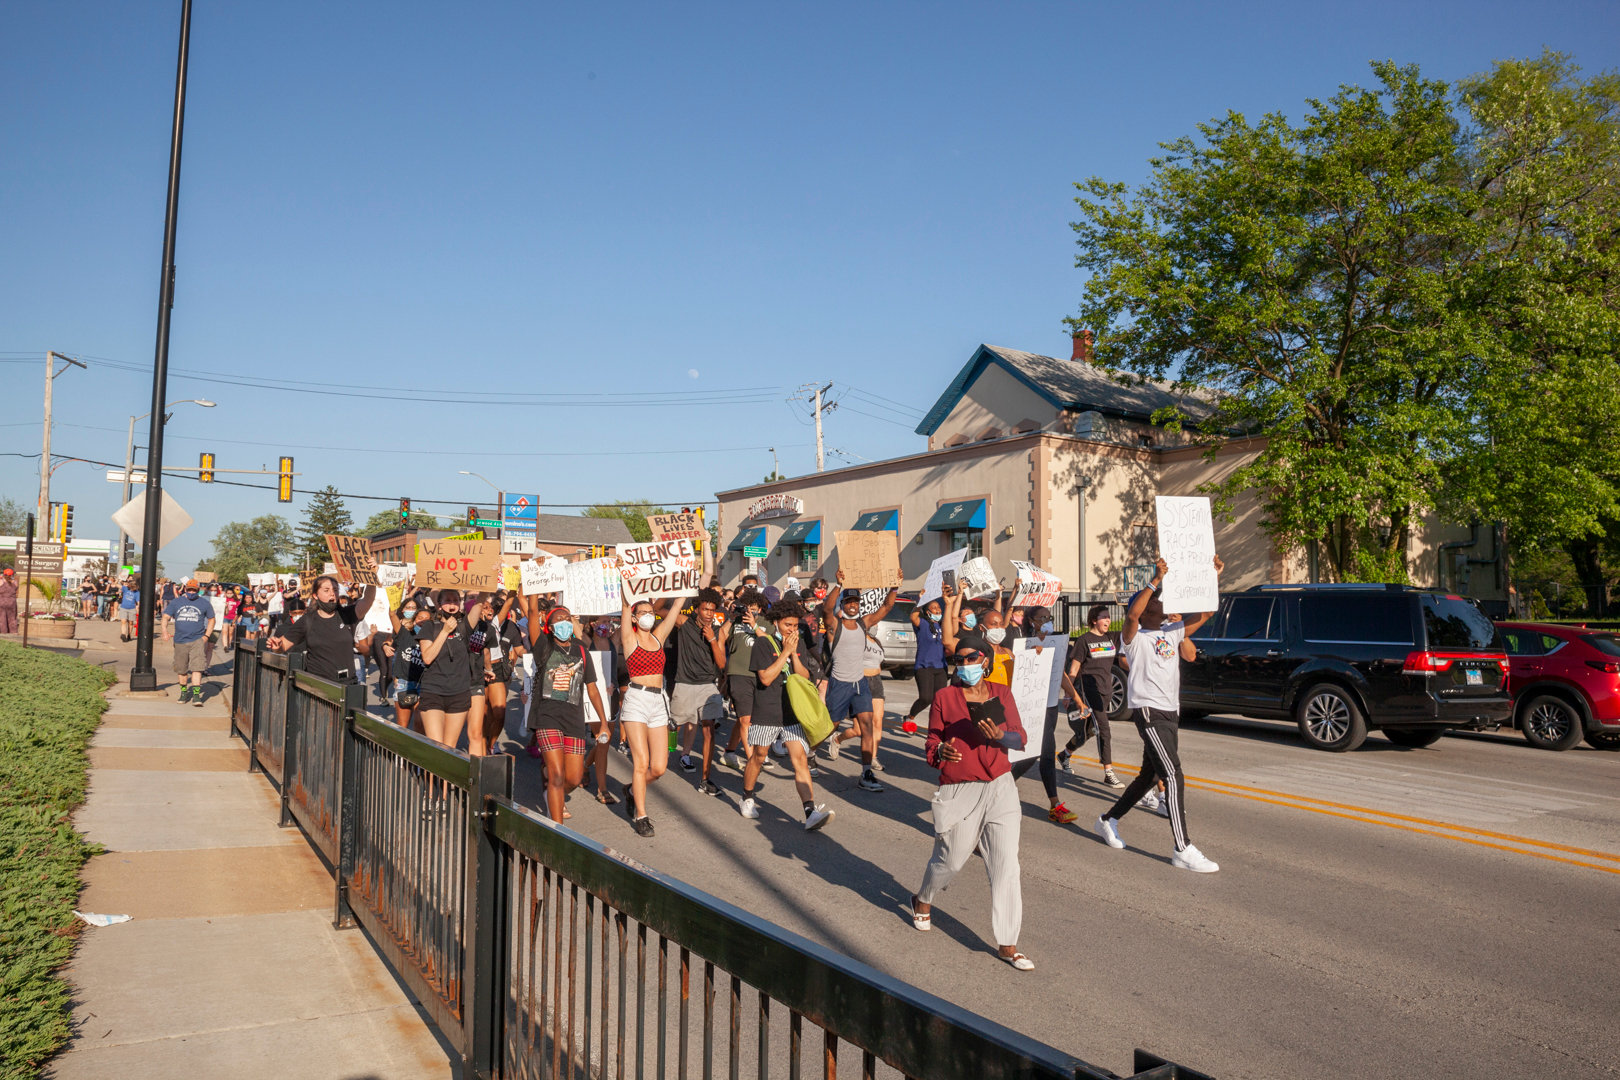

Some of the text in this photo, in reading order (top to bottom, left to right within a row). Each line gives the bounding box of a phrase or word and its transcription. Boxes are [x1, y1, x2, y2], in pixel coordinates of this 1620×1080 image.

[654, 514, 694, 526] BLACK
[663, 523, 694, 533] LIVES
[660, 530, 701, 541] MATTER
[328, 535, 369, 556] BLACK
[423, 542, 484, 556] WE WILL
[624, 540, 691, 565] SILENCE
[35, 560, 60, 569] Surgery
[333, 553, 372, 570] LIVES
[434, 557, 474, 571] NOT
[675, 557, 692, 569] BLM
[1187, 550, 1211, 566] PRODU
[620, 566, 641, 580] BLM
[647, 560, 667, 575] IS
[340, 569, 380, 586] MATTER
[426, 571, 442, 585] BE
[450, 572, 491, 586] SILENT
[526, 578, 551, 587] George
[627, 569, 700, 596] VIOLENCE
[1019, 592, 1059, 607] ATTENTION
[401, 650, 426, 668] BREATH
[405, 647, 421, 658] CAN
